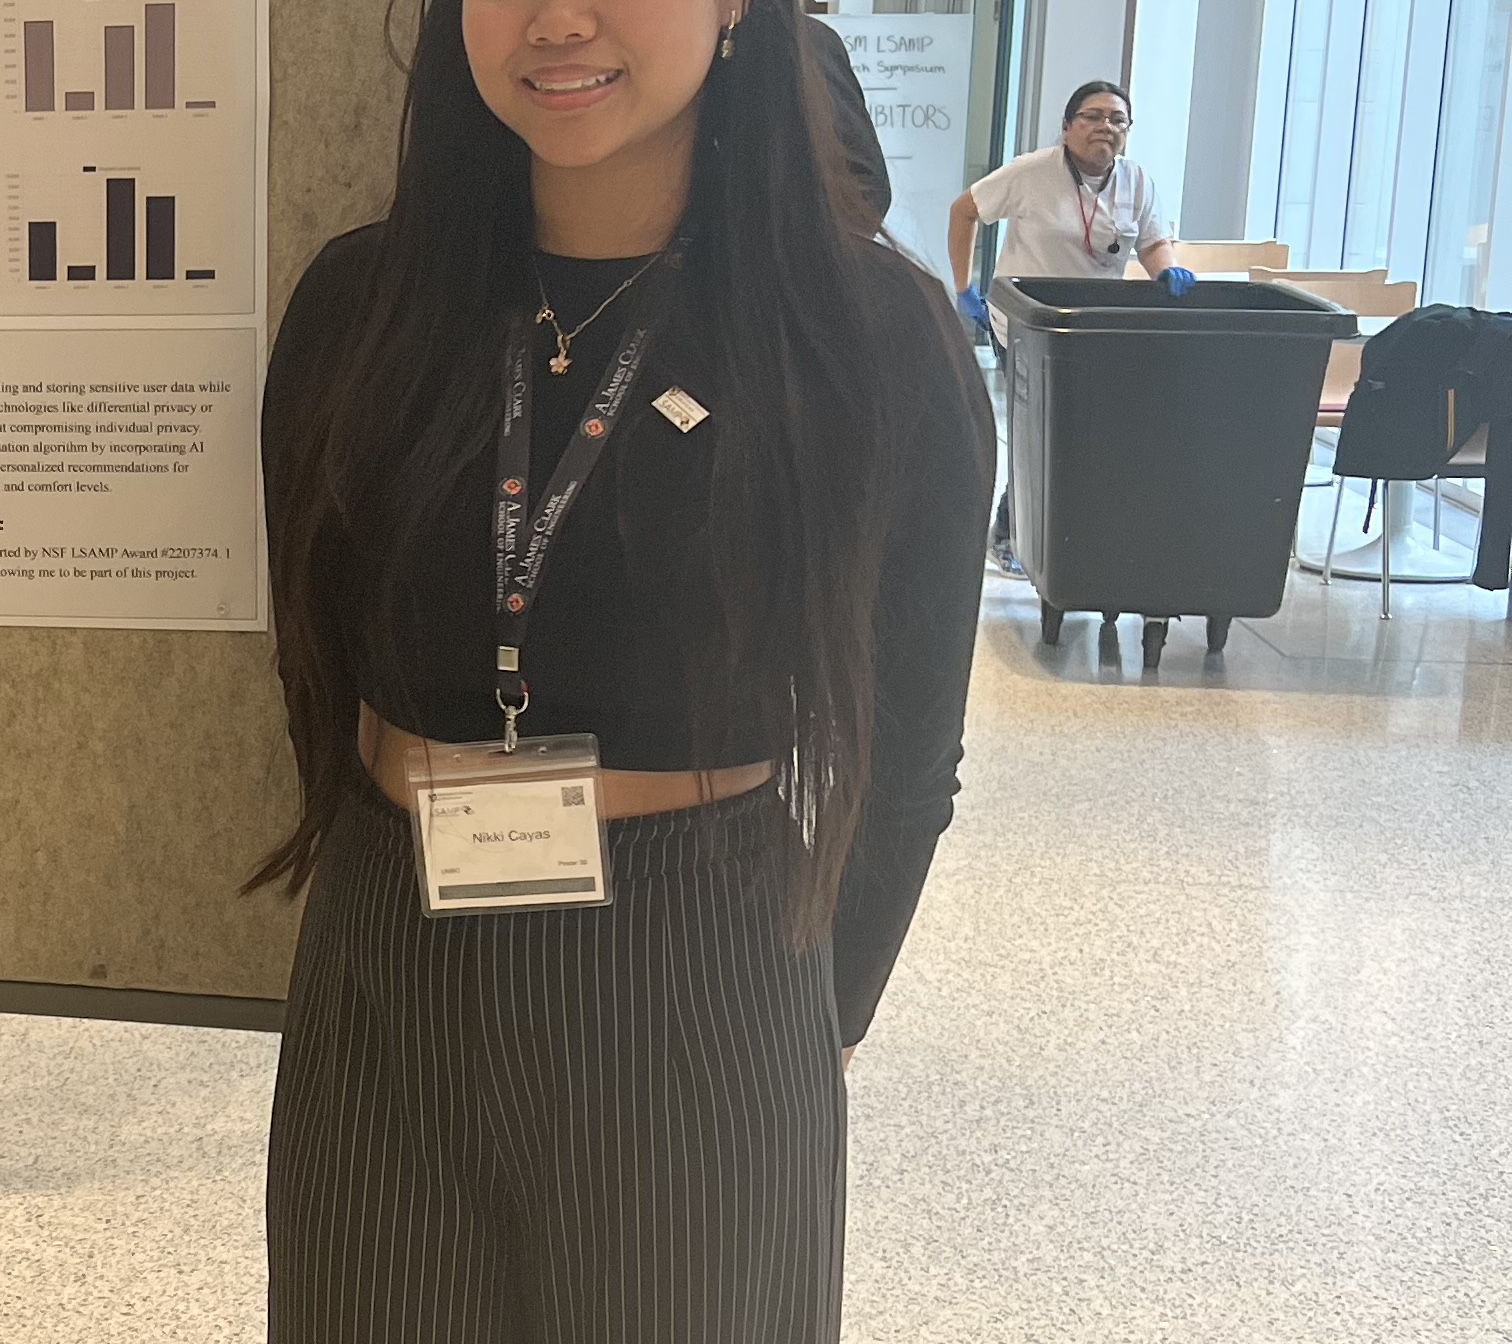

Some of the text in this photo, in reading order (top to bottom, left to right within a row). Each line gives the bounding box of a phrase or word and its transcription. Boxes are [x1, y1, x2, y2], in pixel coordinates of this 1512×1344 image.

[843, 35, 934, 53] SM LSAMP
[877, 60, 945, 79] Symposium
[869, 103, 951, 131] IBITORS
[472, 829, 551, 844] Nikki Cayas
